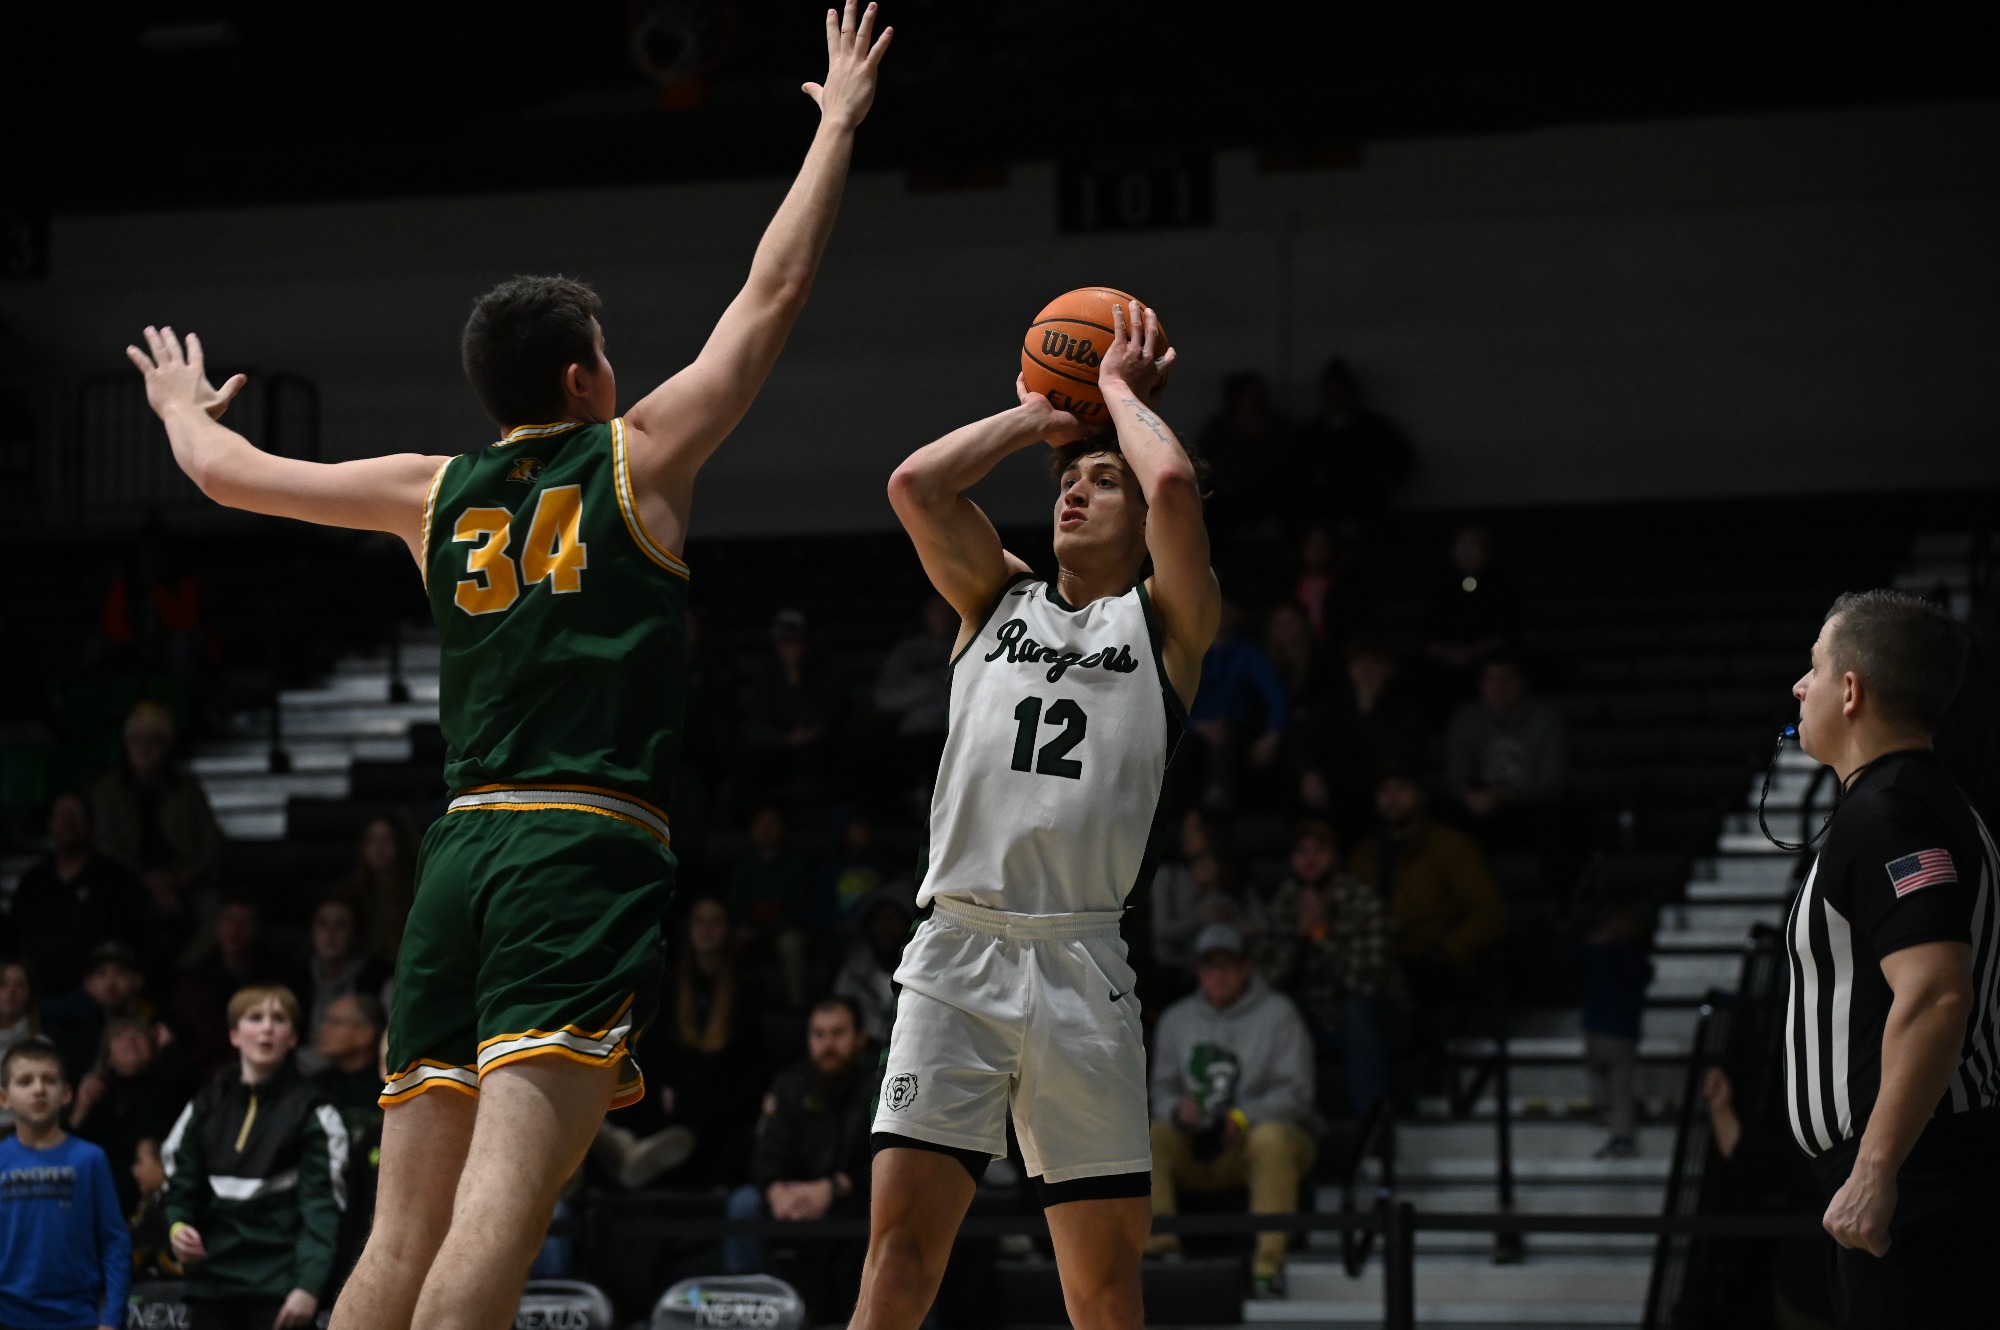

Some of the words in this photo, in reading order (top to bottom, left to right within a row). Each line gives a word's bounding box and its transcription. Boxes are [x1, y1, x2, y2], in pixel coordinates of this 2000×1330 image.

[1041, 329, 1101, 368] Wils
[452, 484, 587, 616] 34
[984, 618, 1139, 683] Rangers
[1011, 696, 1088, 780] 12
[695, 1301, 780, 1328] NEXUS
